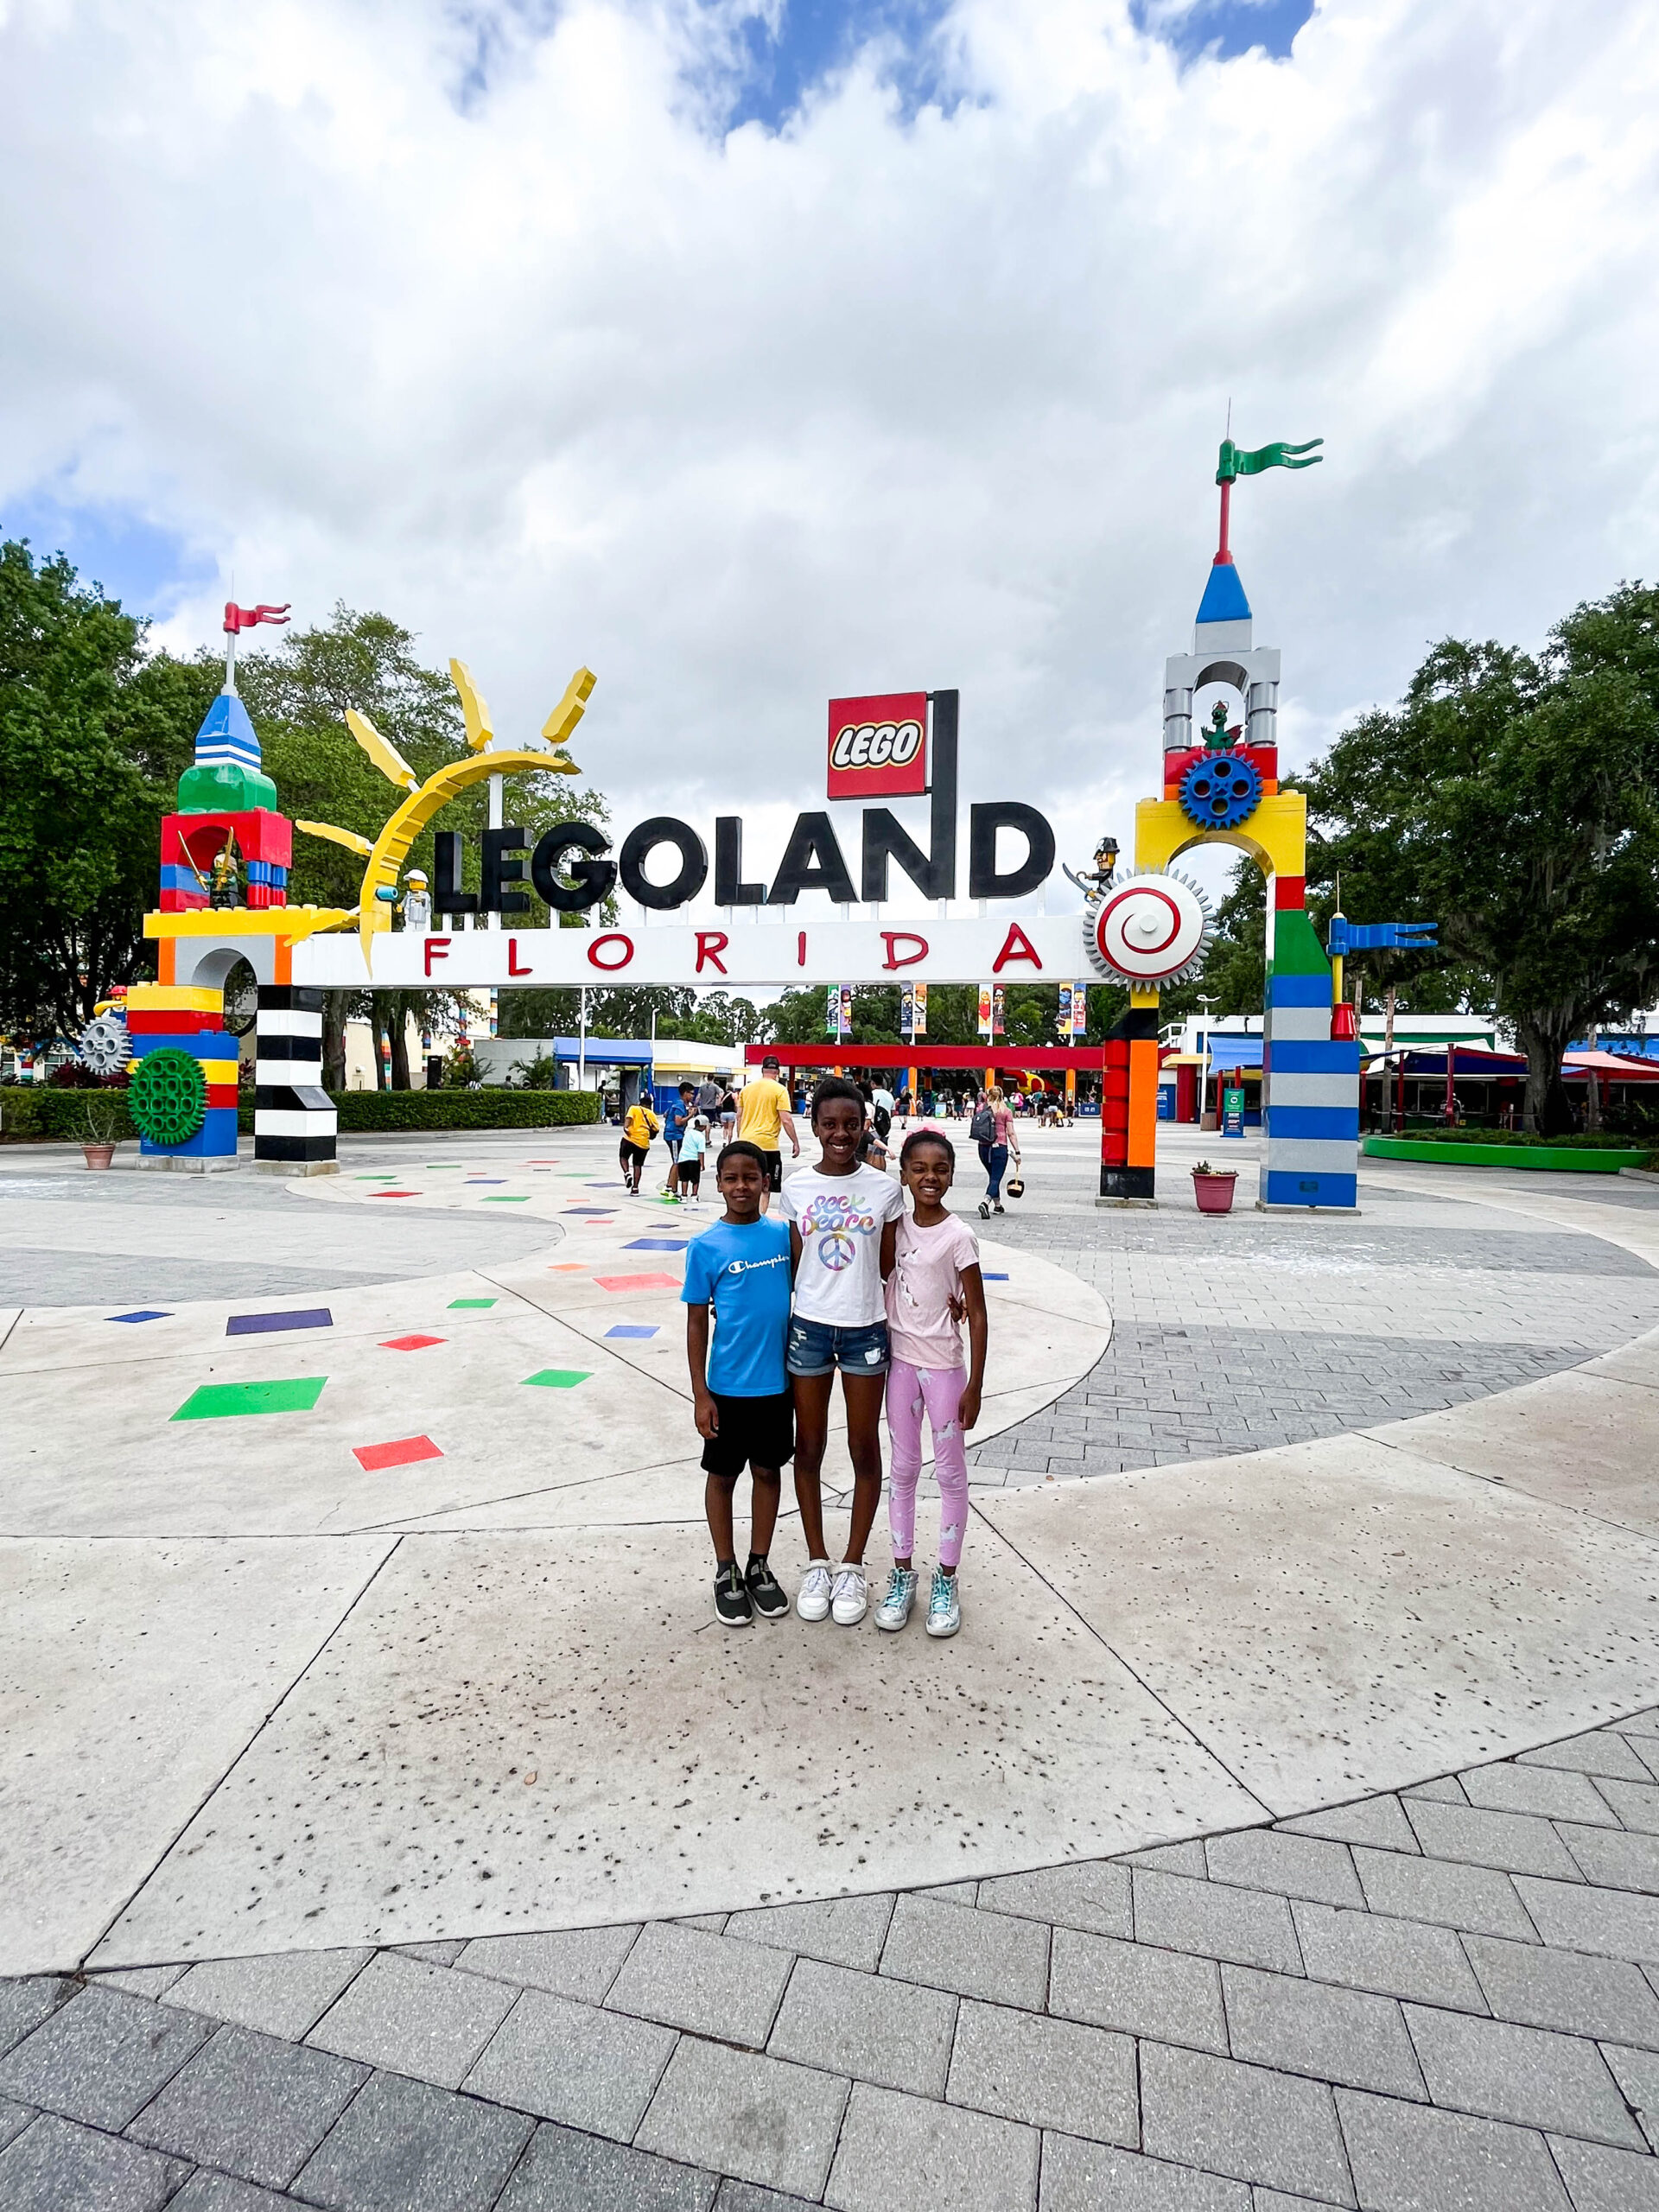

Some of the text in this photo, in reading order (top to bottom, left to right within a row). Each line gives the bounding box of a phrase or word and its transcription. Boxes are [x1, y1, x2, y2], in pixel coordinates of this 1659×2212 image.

[831, 721, 921, 768] LEGO
[434, 800, 1056, 914] LEGOLAND
[424, 922, 1043, 977] FLORIDA
